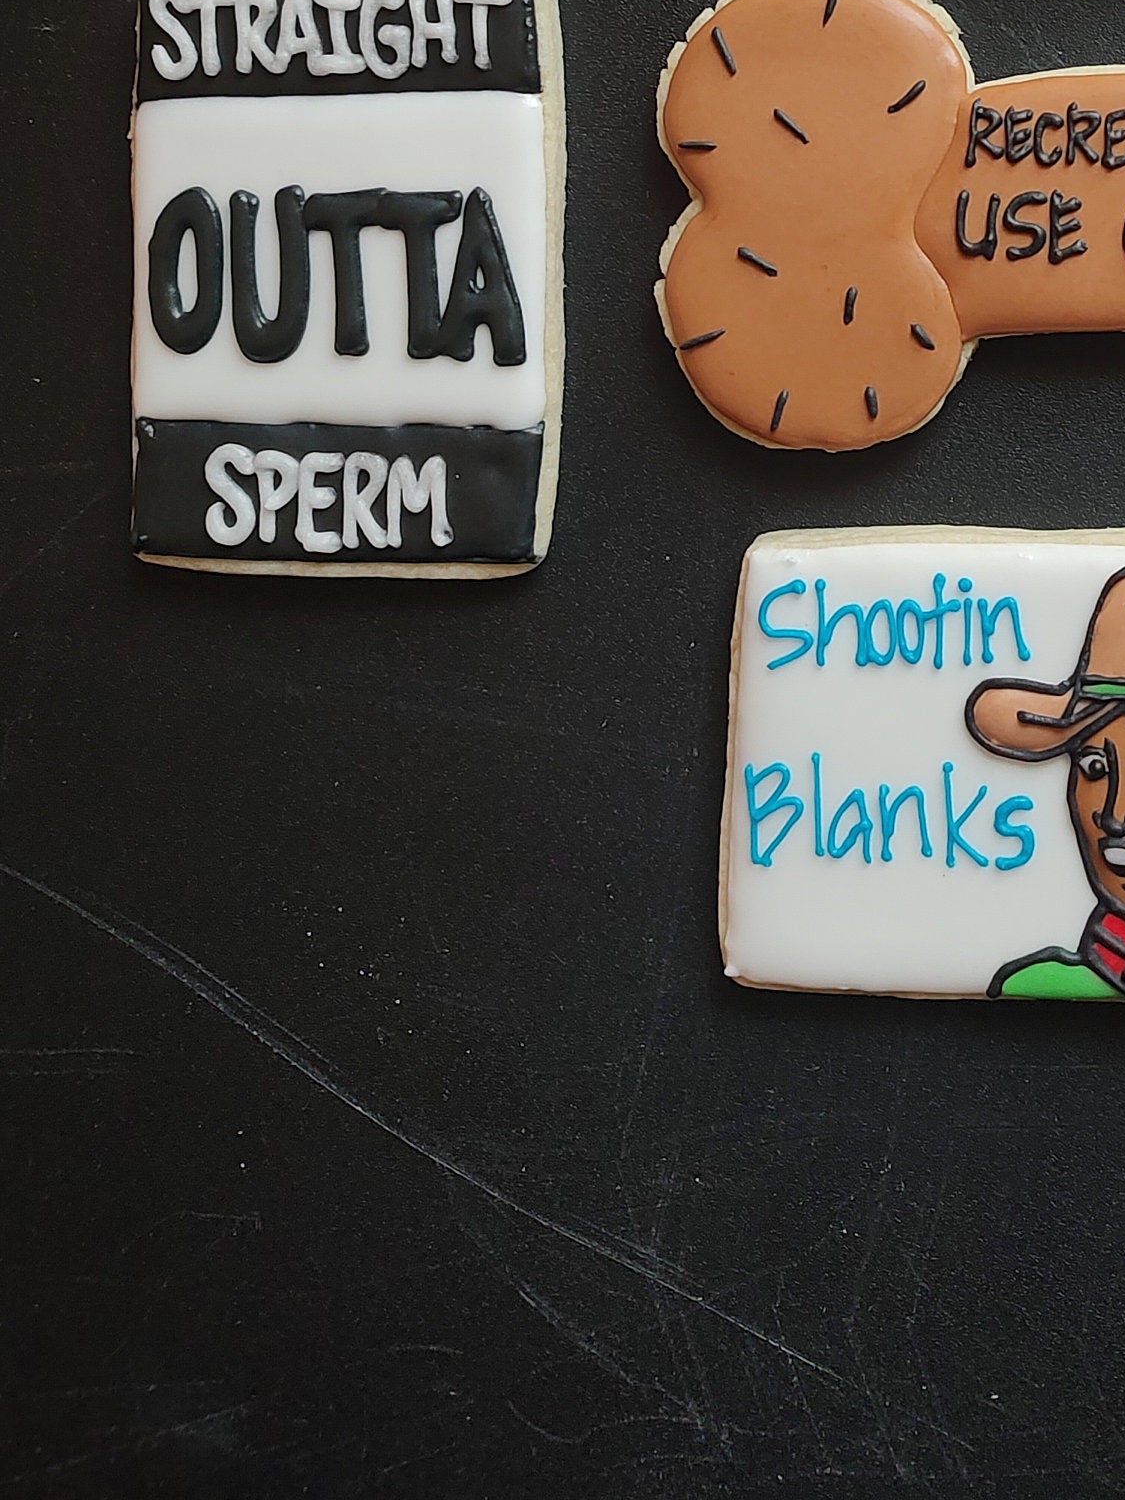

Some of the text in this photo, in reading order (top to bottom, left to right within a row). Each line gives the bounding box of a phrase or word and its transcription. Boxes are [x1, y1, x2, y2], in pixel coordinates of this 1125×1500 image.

[147, 184, 528, 367] OUTTA
[955, 188, 1089, 265] USE
[203, 441, 456, 554] SPERM
[757, 572, 1032, 671] Shootin
[744, 751, 1036, 871] Blanks
